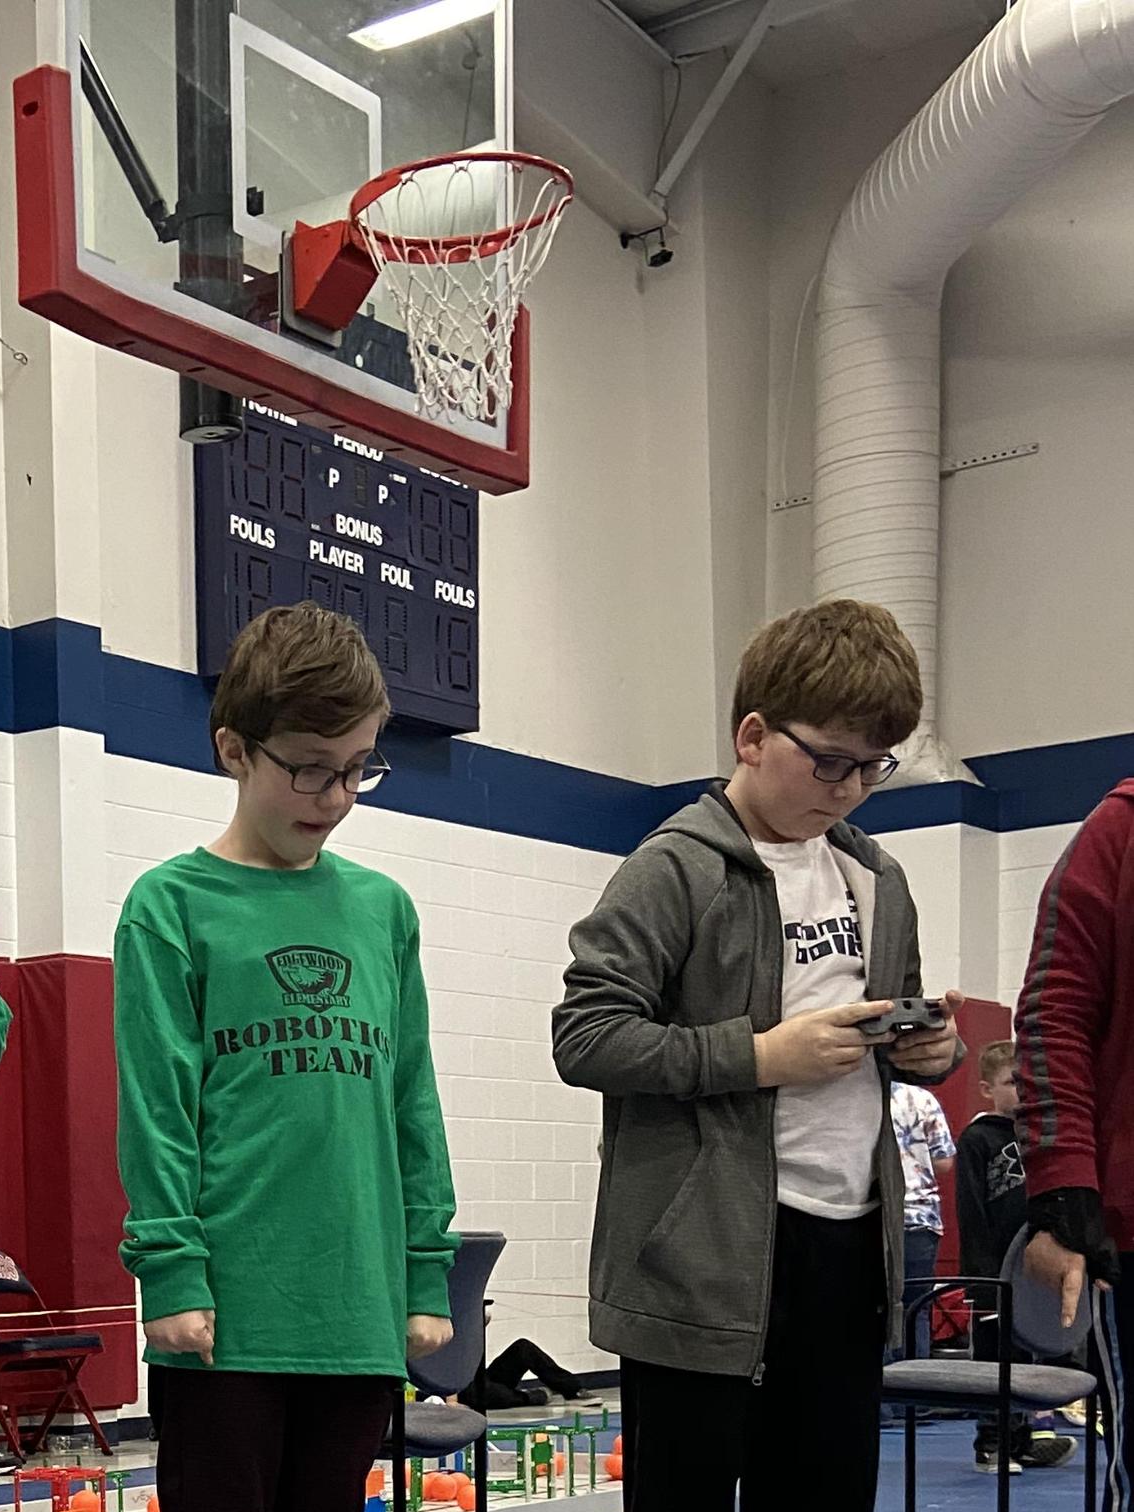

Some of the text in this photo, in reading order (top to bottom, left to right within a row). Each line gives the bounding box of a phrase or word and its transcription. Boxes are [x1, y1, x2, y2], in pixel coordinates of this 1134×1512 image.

[329, 468, 340, 488] P
[378, 485, 389, 504] P
[230, 514, 275, 549] FOULS
[336, 513, 383, 546] BONUS
[310, 540, 414, 591] PLAYER FOUL
[435, 580, 475, 609] FOULS
[276, 952, 345, 971] EDGEWOOD
[284, 993, 350, 1007] ELEMENTARY
[263, 1047, 375, 1080] TEAM
